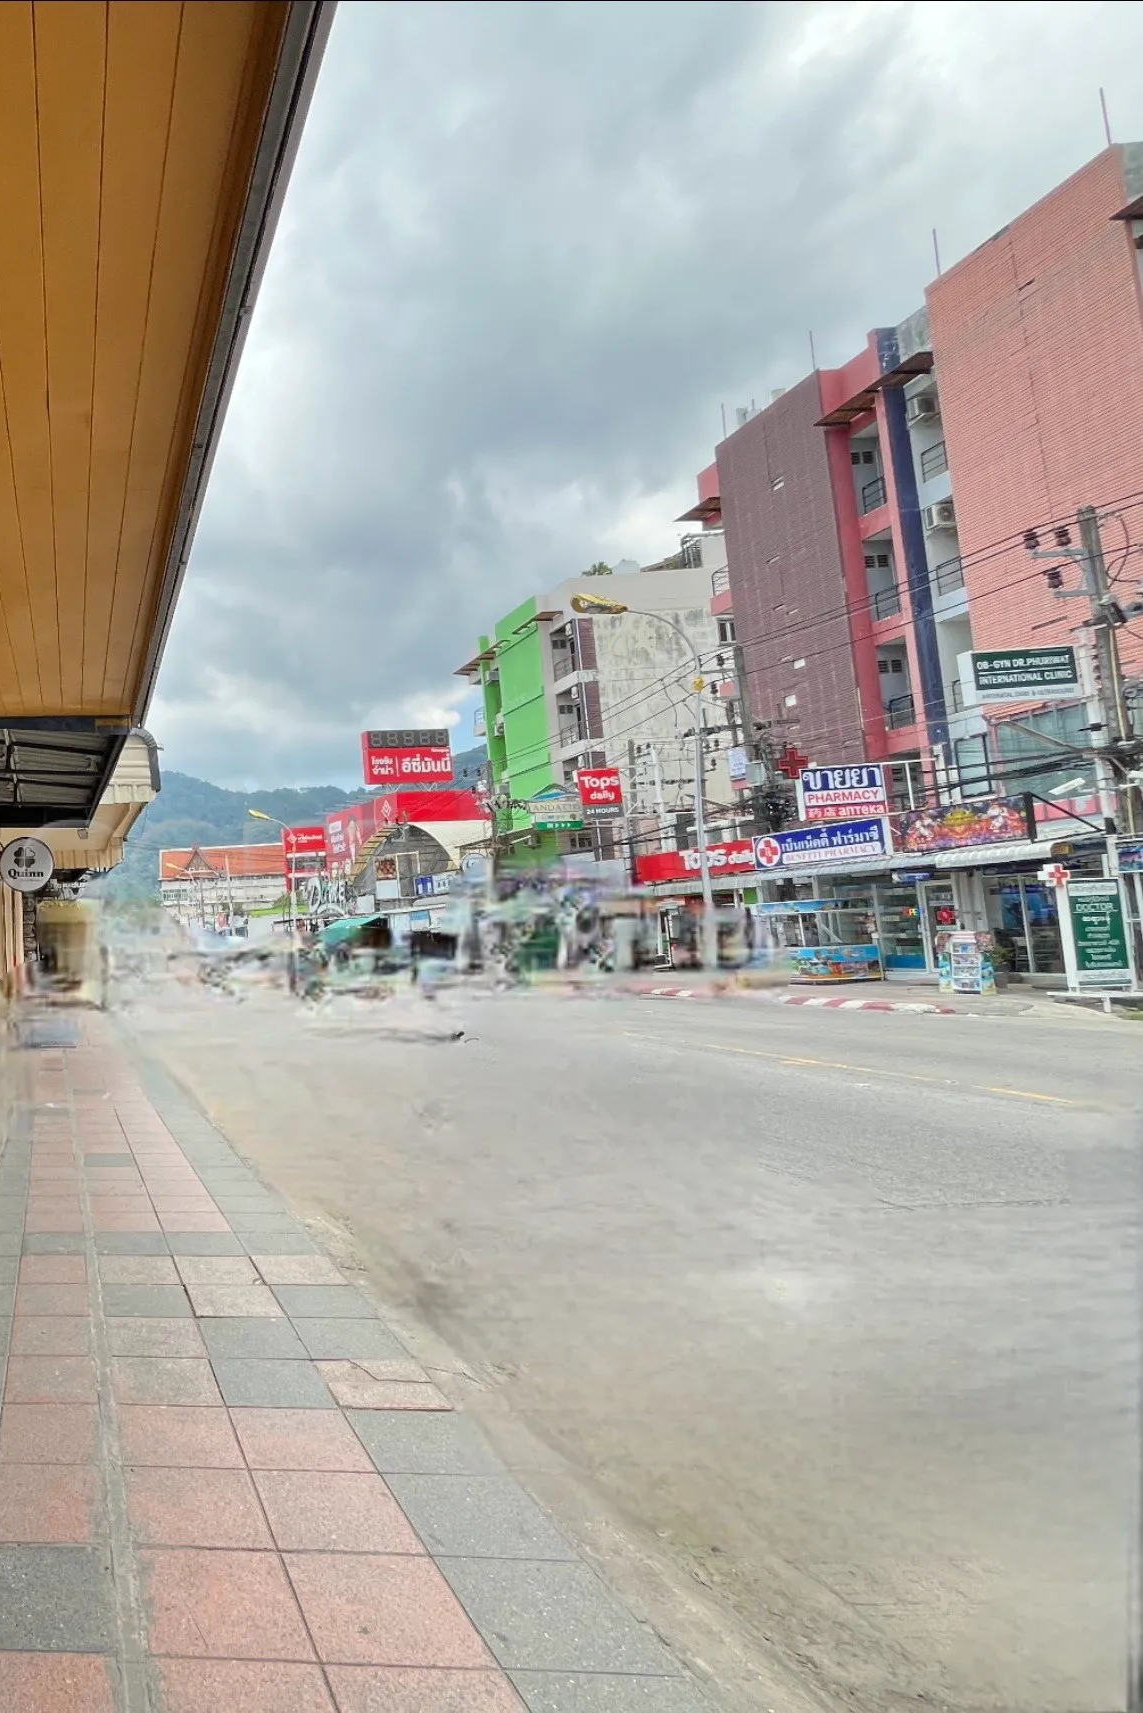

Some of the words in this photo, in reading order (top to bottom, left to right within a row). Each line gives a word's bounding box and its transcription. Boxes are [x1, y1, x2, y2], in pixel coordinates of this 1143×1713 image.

[977, 660, 1011, 670] OB-GYN
[979, 673, 1042, 685] INTERNATIONAL
[1044, 671, 1072, 680] CLINIC
[579, 775, 619, 789] Tops
[802, 767, 881, 790] ขายยา
[589, 790, 615, 800] daily
[807, 790, 879, 804] PHARMACY
[824, 844, 876, 859] PHARMACY
[8, 868, 44, 879] Quinn
[1075, 902, 1114, 912] DOCTOR
